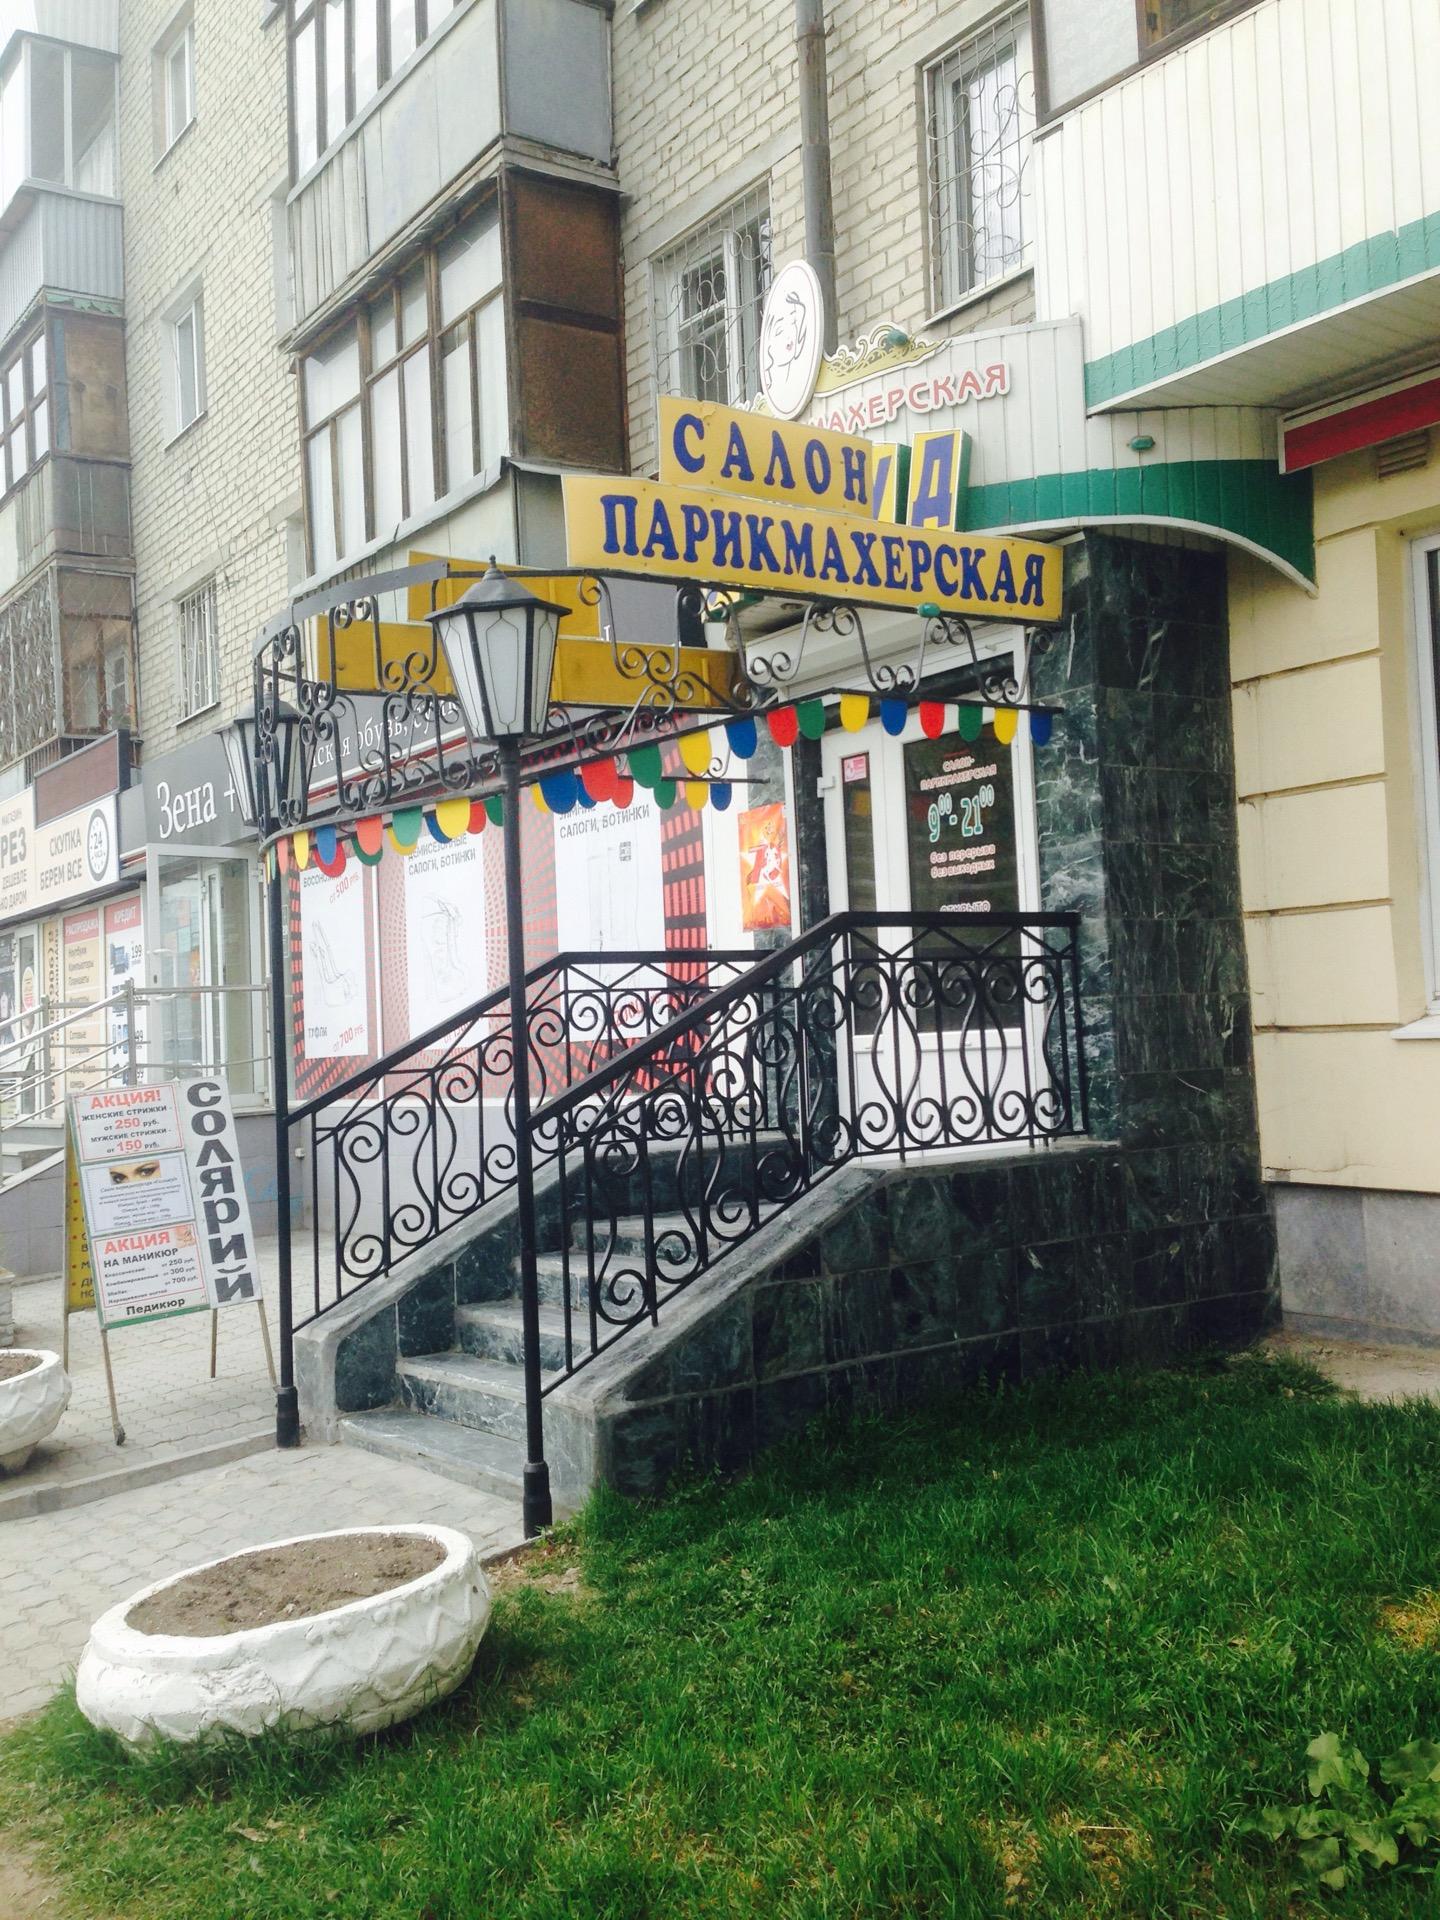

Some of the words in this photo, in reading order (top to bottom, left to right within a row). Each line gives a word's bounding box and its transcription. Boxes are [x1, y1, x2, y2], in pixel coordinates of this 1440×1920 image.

[672, 413, 868, 505] САЛОН
[600, 494, 1046, 607] ПАРИКМАХЕРСКАЯ
[920, 764, 998, 791] ПАРИКМАХЕРСКАЯ
[157, 781, 217, 839] Зена
[602, 804, 649, 829] БОТИНКИ
[49, 828, 82, 856] СКУПКА
[440, 848, 476, 868] БОТИНКИ
[930, 851, 947, 864] без
[949, 844, 996, 862] перерыва
[40, 864, 65, 891] БЕРЕМ
[67, 858, 82, 880] ВСЕ
[339, 1027, 354, 1048] 700
[91, 1089, 161, 1110] АКЦИЯ!
[82, 1109, 124, 1122] ЖЕНСКИЕ
[126, 1105, 167, 1116] СТРИЖКИ
[114, 1117, 141, 1130] 250
[90, 1132, 128, 1143] МУЖСКИЕ
[130, 1128, 167, 1138] СТРИЖКИ
[116, 1139, 142, 1152] 150
[104, 1231, 171, 1254] АКЦИЯ
[104, 1258, 120, 1268] НА
[122, 1248, 179, 1265] МАНИКЮР
[169, 1258, 183, 1267] 250
[170, 1266, 184, 1275] 300
[172, 1275, 186, 1284] 700
[126, 1298, 186, 1316] Педикюр
